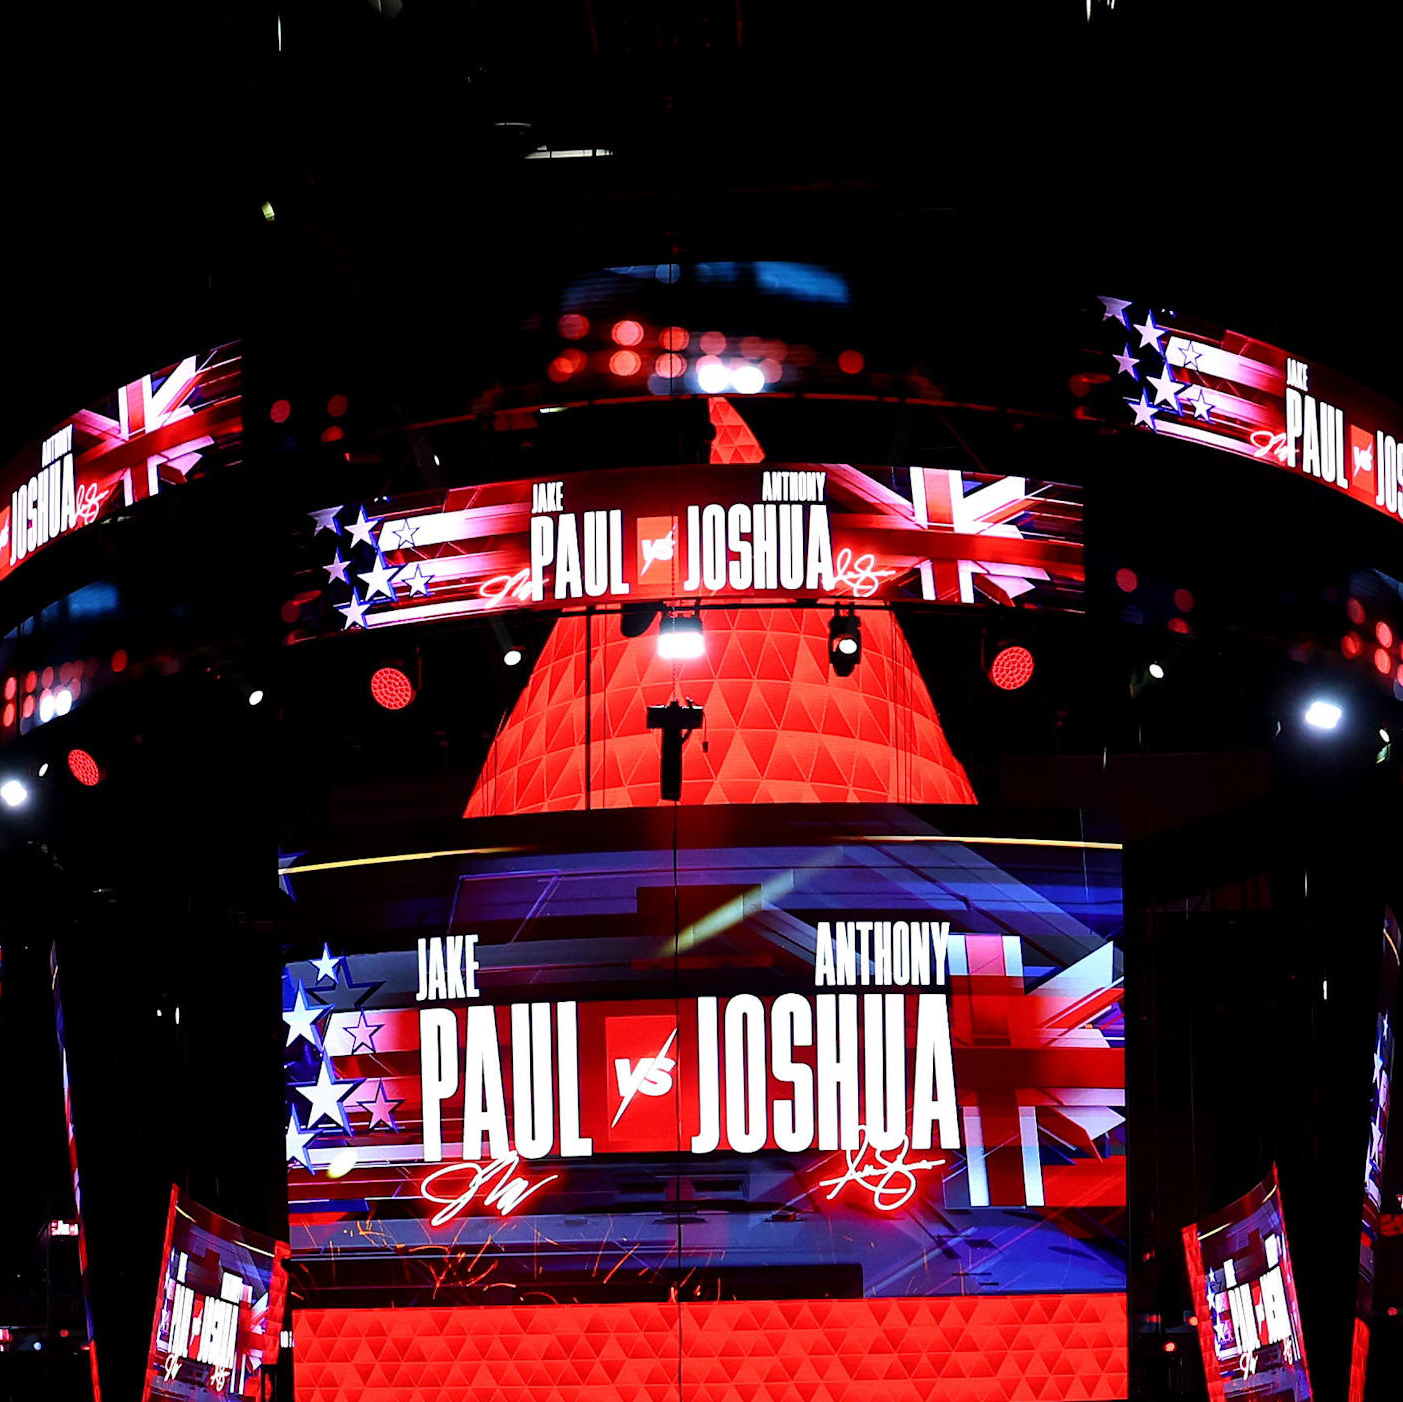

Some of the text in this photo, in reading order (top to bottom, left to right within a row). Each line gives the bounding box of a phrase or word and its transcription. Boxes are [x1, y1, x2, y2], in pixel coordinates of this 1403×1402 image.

[1286, 387, 1349, 489] PAUL
[10, 453, 77, 567] JOSHUA
[531, 481, 564, 514] JAKE
[761, 471, 827, 501] ANTHONY
[529, 508, 630, 602] PAUL
[683, 503, 837, 591] JOSHUA
[416, 934, 481, 1001] JAKE
[815, 921, 950, 986] ANTHONY
[419, 1000, 593, 1162] PAUL
[691, 993, 961, 1154] JOSHUA
